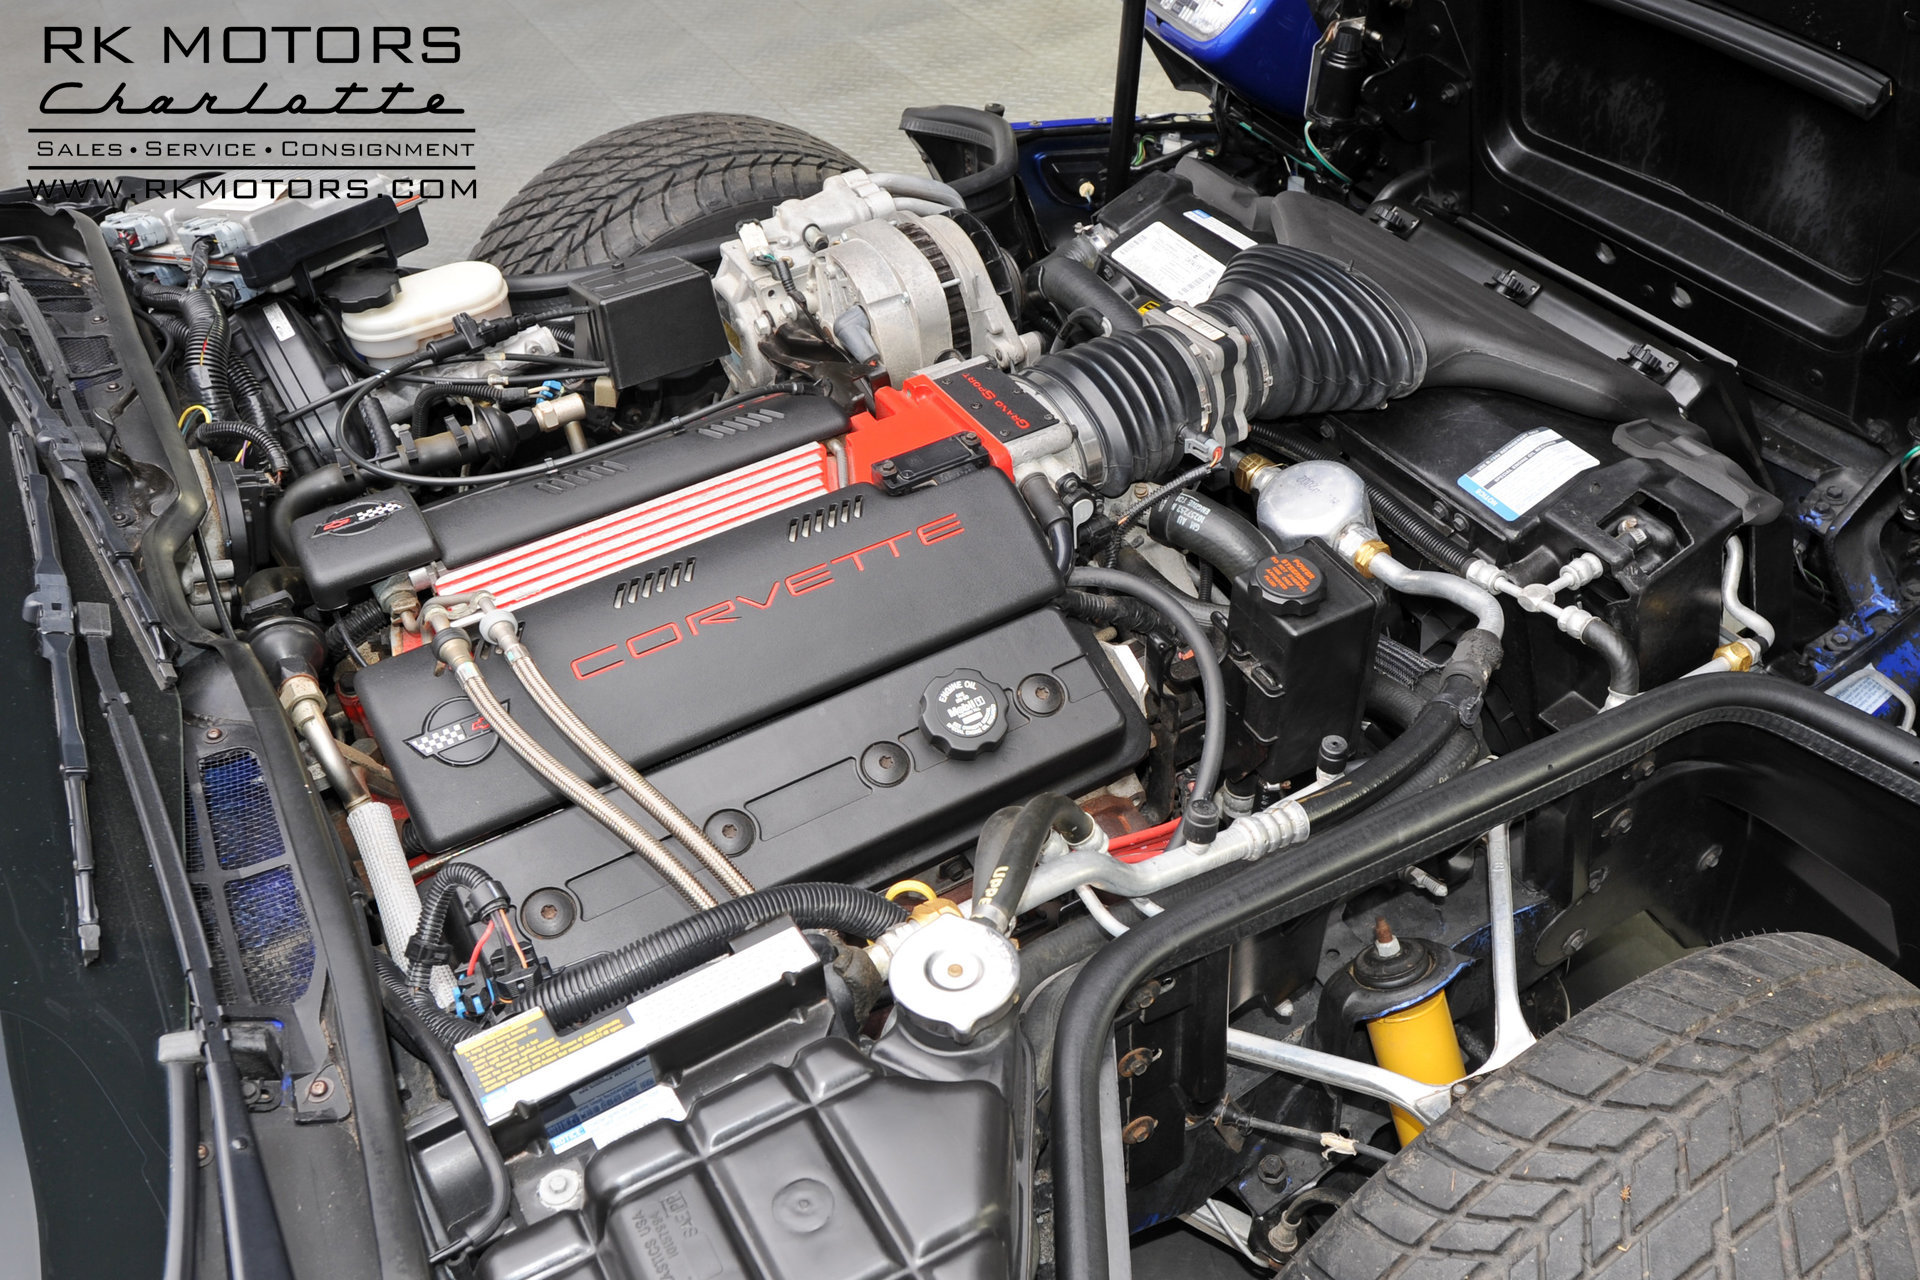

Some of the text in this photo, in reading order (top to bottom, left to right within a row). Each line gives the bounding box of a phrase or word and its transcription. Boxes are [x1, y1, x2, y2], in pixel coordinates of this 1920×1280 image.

[569, 511, 967, 681] CORVETTE
[938, 680, 978, 703] ENGINE OIL
[946, 699, 976, 718] Mobil
[631, 1208, 652, 1238] USA
